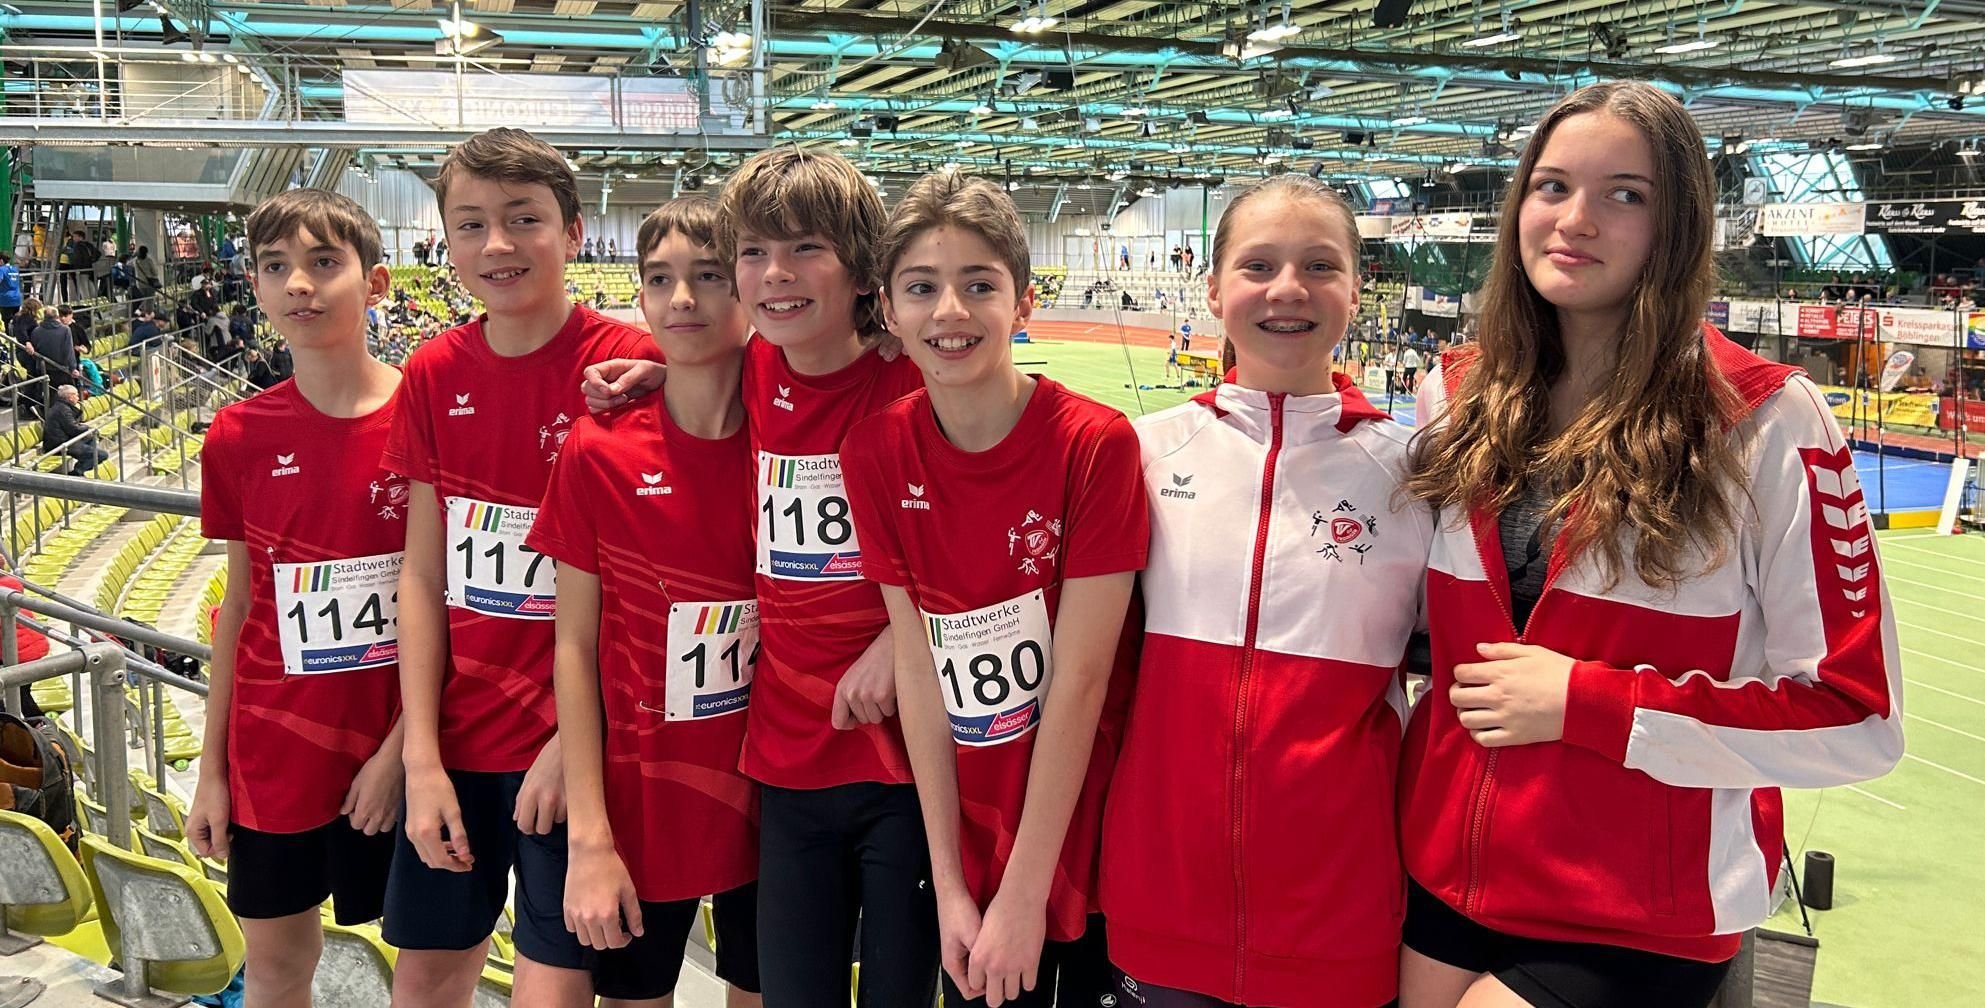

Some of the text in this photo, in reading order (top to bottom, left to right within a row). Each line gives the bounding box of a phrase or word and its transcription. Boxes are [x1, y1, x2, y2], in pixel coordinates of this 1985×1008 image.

[1898, 319, 1961, 332] Kreissparkas
[449, 406, 475, 416] erima
[272, 465, 300, 477] erima
[636, 485, 672, 496] erima
[1160, 487, 1196, 500] erima
[901, 498, 930, 510] erima
[762, 495, 852, 546] 118
[333, 556, 404, 575] Stadtwerke
[456, 536, 556, 588] 117
[331, 573, 379, 584] Sindelfingen
[941, 604, 1021, 630] Stadtwerke
[943, 617, 1020, 642] Sindelfingen GmbH
[941, 639, 1044, 709] 180
[993, 711, 1029, 731] elsässer
